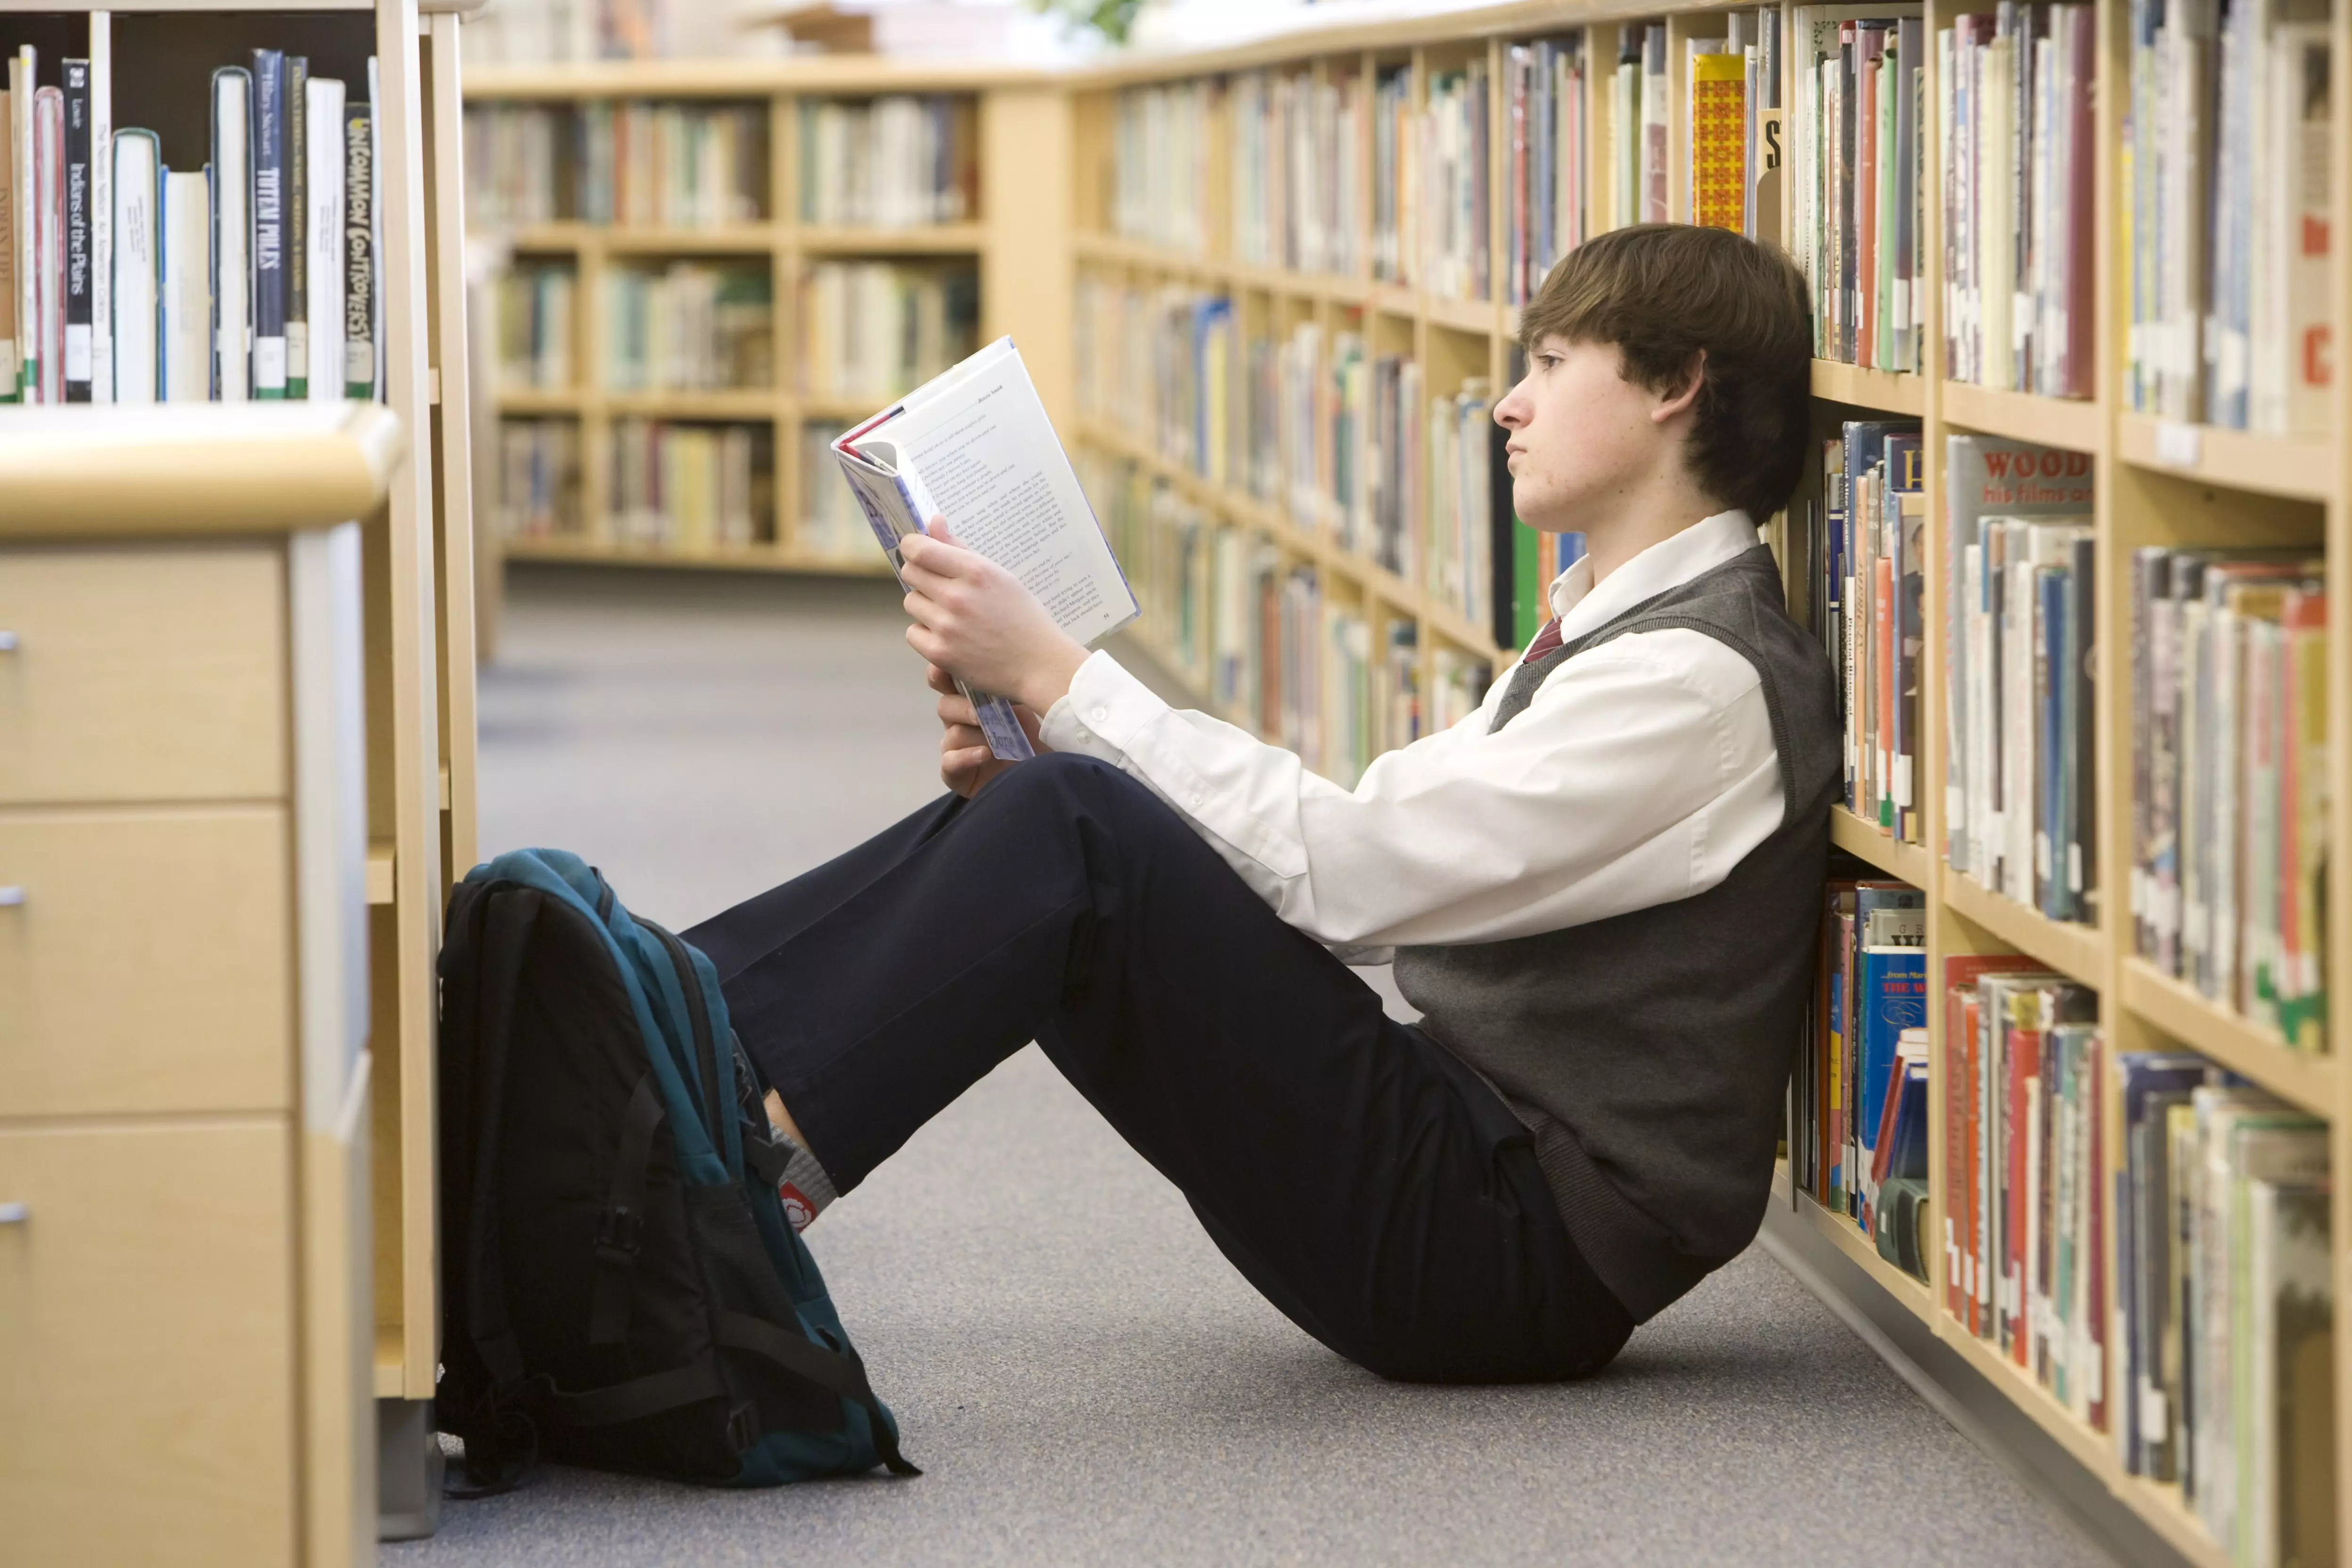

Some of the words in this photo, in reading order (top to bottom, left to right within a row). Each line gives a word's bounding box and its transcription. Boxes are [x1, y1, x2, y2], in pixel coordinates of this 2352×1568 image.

[72, 98, 83, 129] Lowie
[71, 163, 85, 212] Indians
[347, 117, 372, 225] UNCOMMON
[257, 168, 280, 220] TOTEM
[71, 212, 85, 229] of
[71, 229, 85, 252] the
[257, 223, 280, 270] POLES
[71, 253, 85, 295] Plains
[347, 227, 372, 343] CONTROVERSY
[977, 392, 990, 403] Bessie
[990, 384, 1003, 394] Smith
[1983, 484, 2013, 504] his
[1882, 982, 1910, 994] THE
